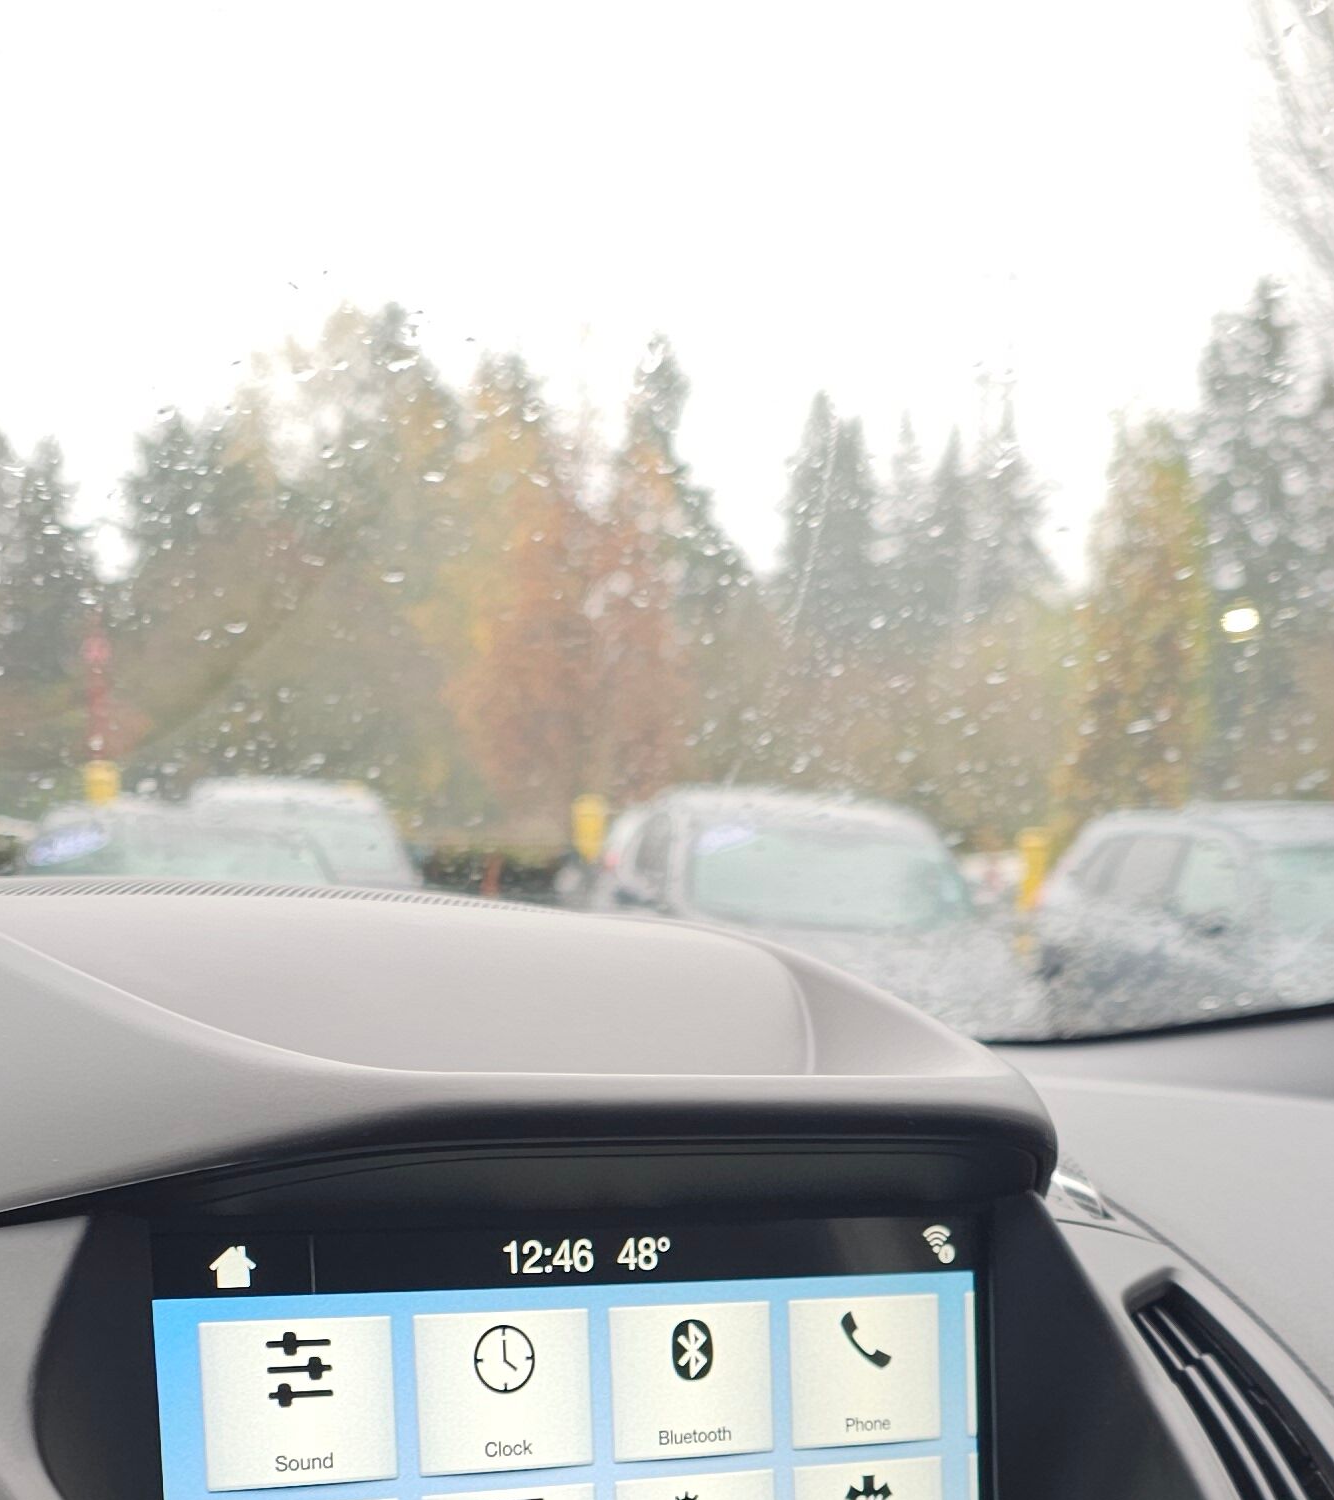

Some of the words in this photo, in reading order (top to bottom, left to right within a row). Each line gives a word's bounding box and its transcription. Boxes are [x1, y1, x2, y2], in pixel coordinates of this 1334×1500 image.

[502, 1239, 594, 1275] 12:46
[617, 1236, 672, 1272] 48°
[845, 1416, 892, 1434] Phone
[658, 1426, 733, 1446] Bluetooth
[484, 1438, 534, 1459] Clock
[274, 1452, 335, 1473] Sound
